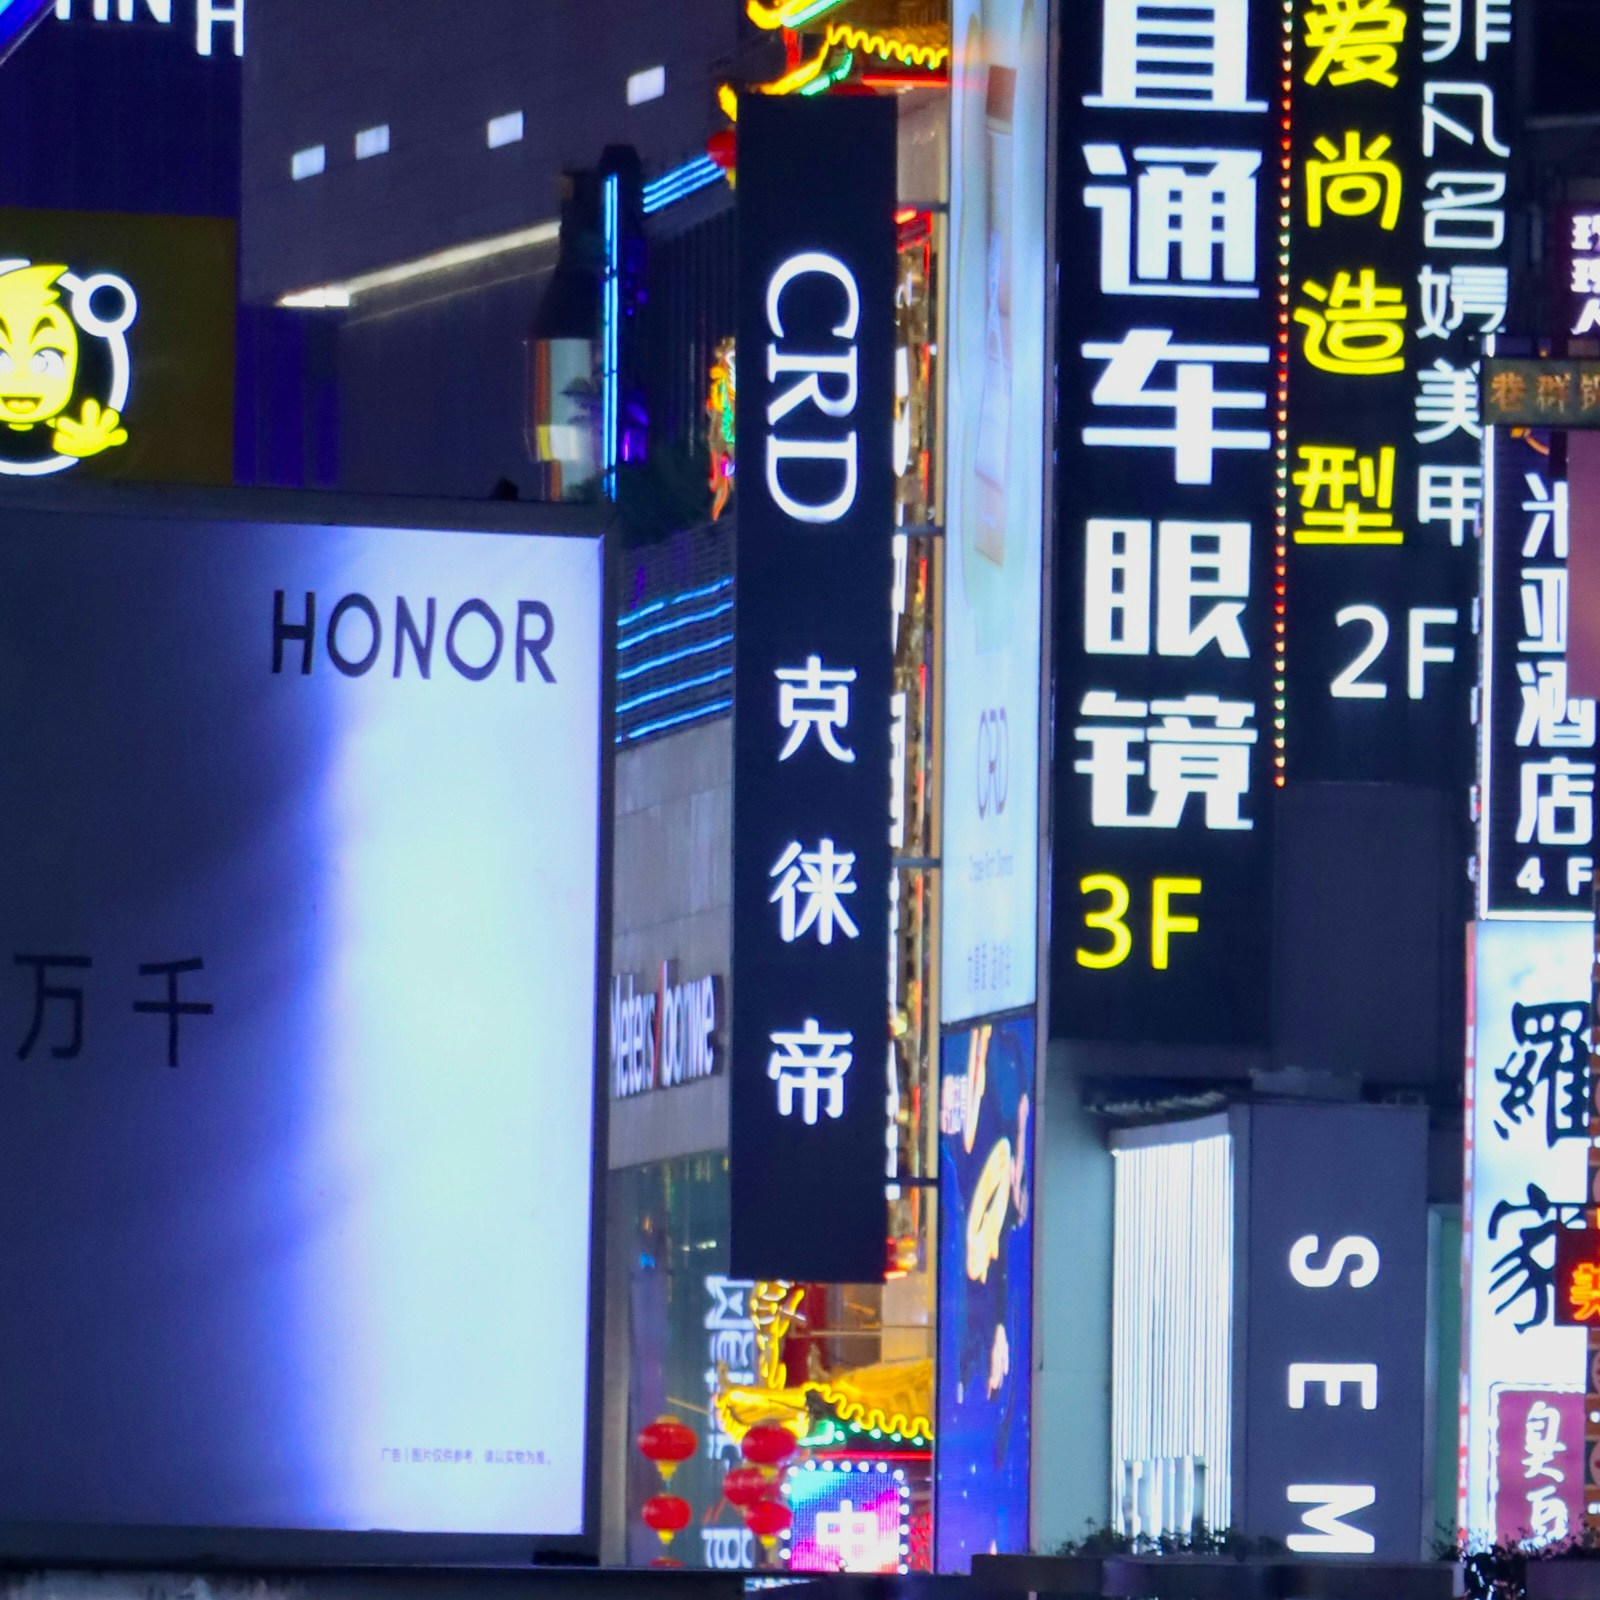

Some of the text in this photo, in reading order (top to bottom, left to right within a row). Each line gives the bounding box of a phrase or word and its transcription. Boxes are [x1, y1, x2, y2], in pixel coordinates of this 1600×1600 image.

[766, 251, 861, 524] CRD
[1293, 0, 1407, 545] 爱尚造型
[1073, 0, 1271, 830] 直通车眼镜
[272, 590, 557, 684] HONOR
[1330, 604, 1459, 699] 2F
[767, 654, 860, 1125] 克徕帝
[1076, 874, 1203, 970] 3F
